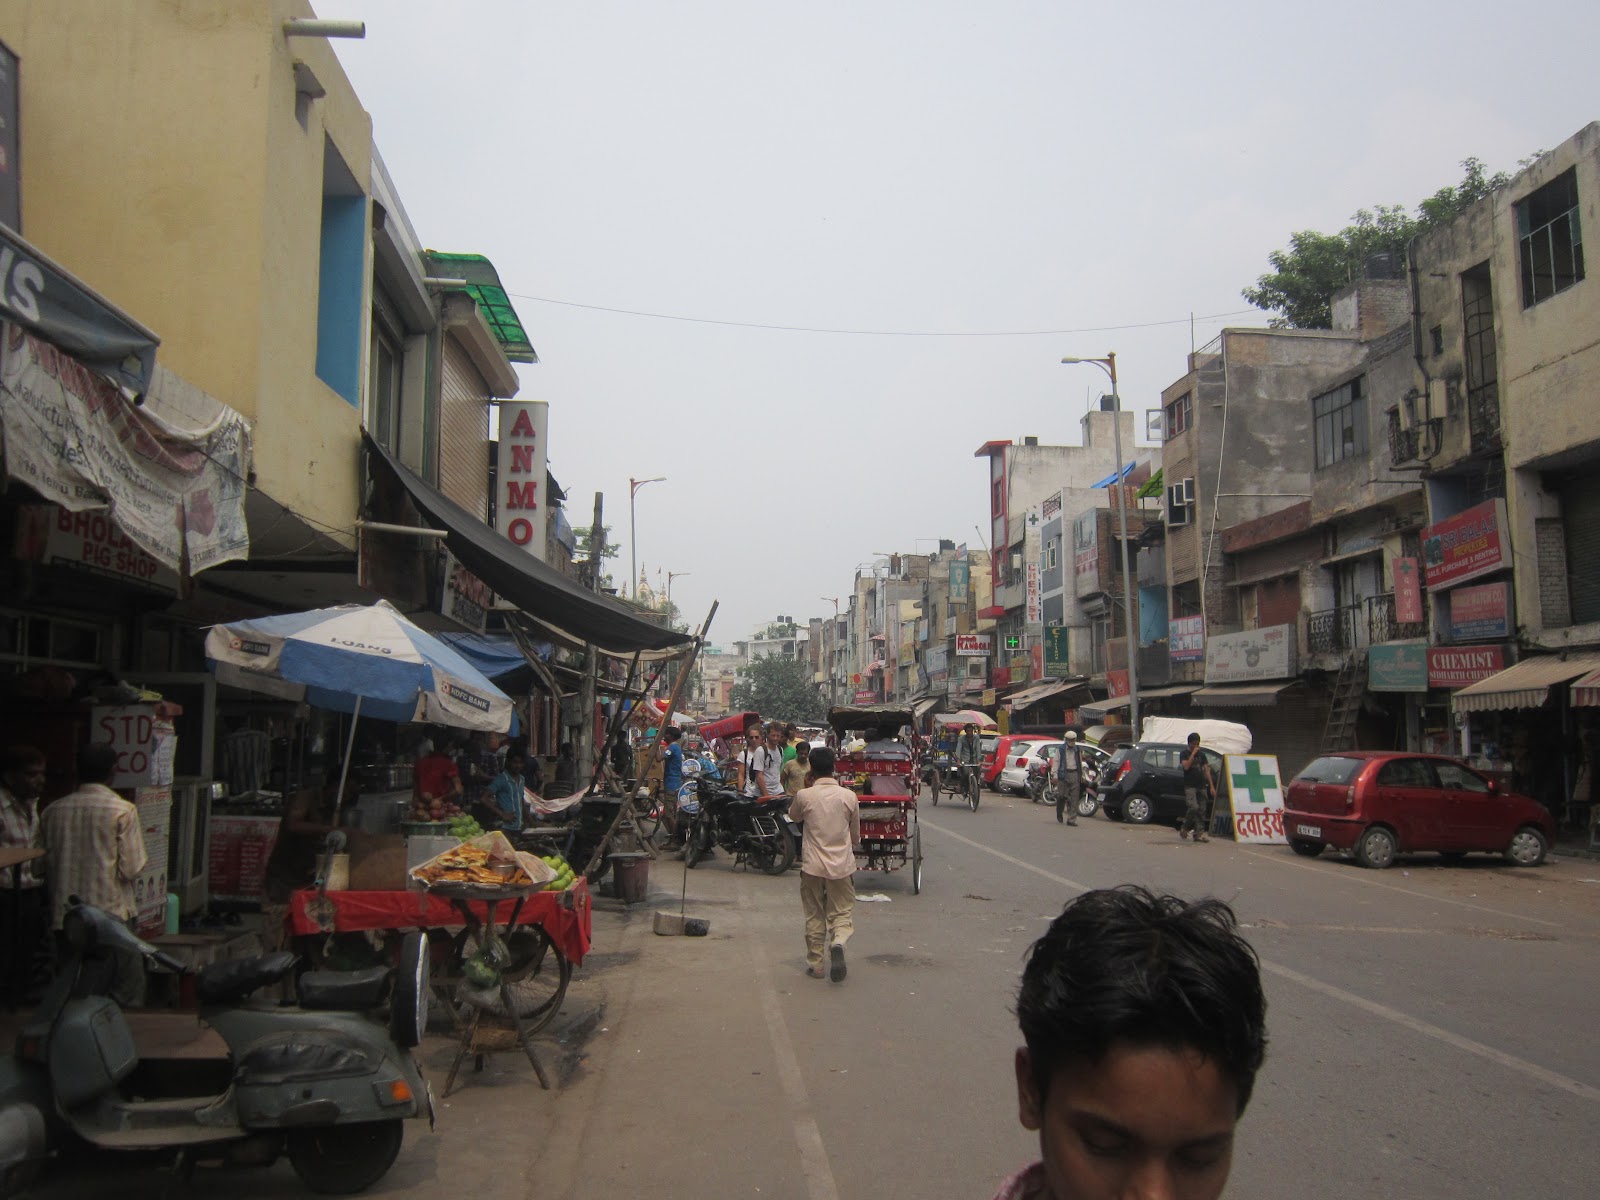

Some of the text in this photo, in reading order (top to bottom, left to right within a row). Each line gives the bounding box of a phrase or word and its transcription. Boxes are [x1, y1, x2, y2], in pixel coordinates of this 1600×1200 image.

[1442, 512, 1497, 550] SRI BALAJI
[117, 551, 158, 578] SHOP
[1442, 559, 1469, 574] PURCHASE
[1474, 547, 1499, 561] RENTING
[330, 637, 392, 655] LOANS
[1432, 651, 1494, 670] CHEMIST
[1429, 670, 1465, 680] SIDHARTH
[451, 687, 488, 709] HDFC BANK
[100, 714, 153, 745] STD
[114, 751, 148, 773] CO
